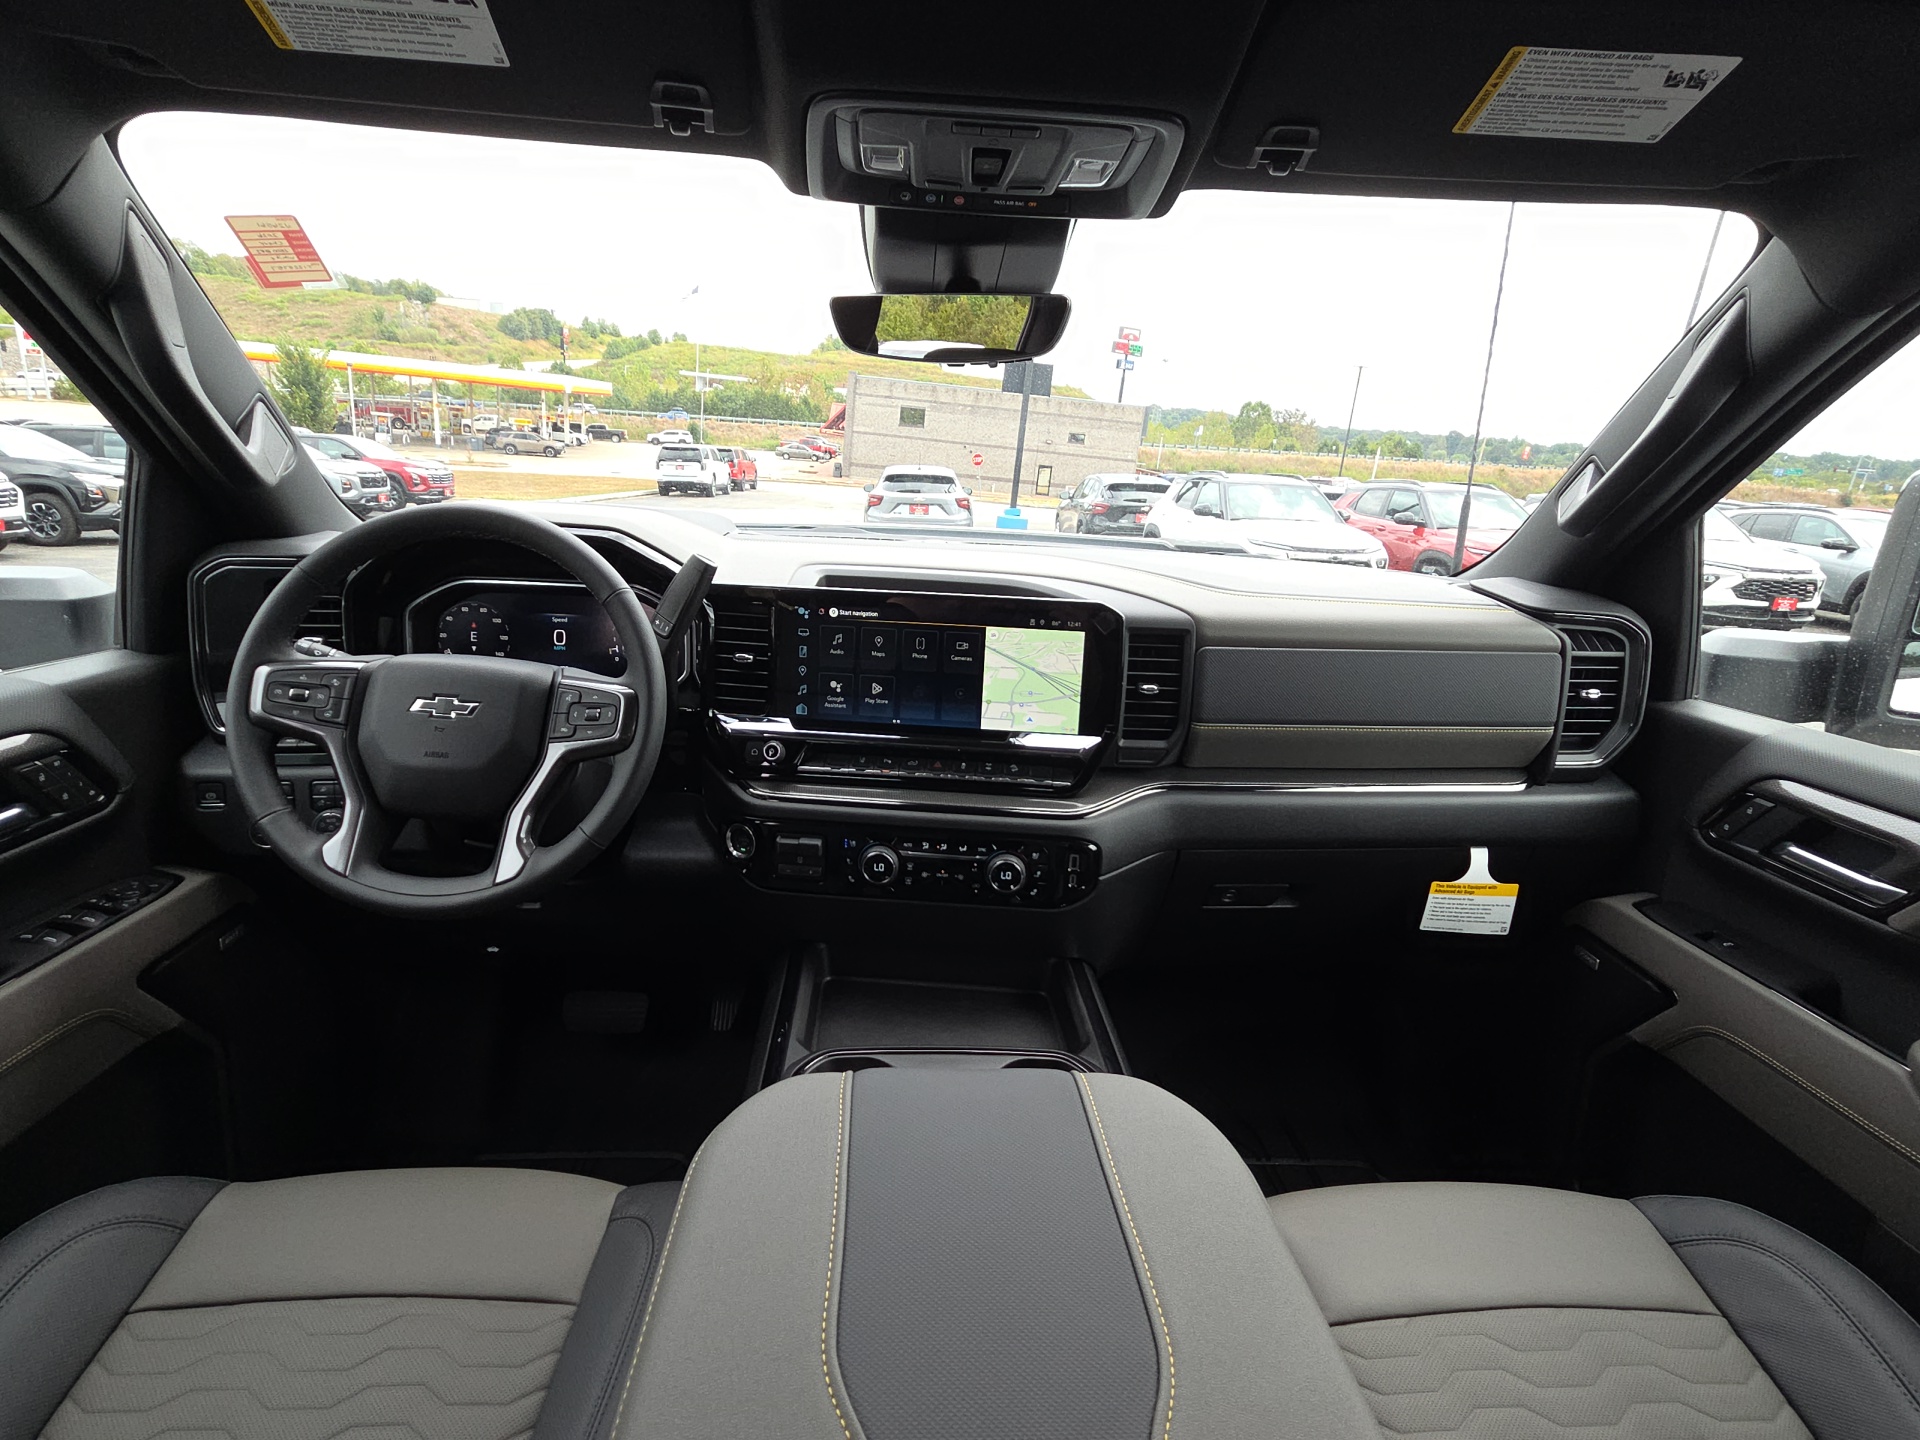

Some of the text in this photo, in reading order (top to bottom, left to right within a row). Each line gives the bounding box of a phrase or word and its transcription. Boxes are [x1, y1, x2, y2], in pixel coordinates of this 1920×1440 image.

[293, 3, 314, 11] AVEC
[334, 6, 354, 14] SACS
[356, 8, 406, 18] GONFLABLES
[408, 13, 462, 24] INTELLIGENTS
[1572, 52, 1614, 60] ADVANCED
[1618, 98, 1668, 106] INTELLIGENTS
[470, 631, 478, 642] E
[553, 629, 566, 645] 0
[873, 863, 884, 871] LO
[1000, 872, 1012, 880] LO
